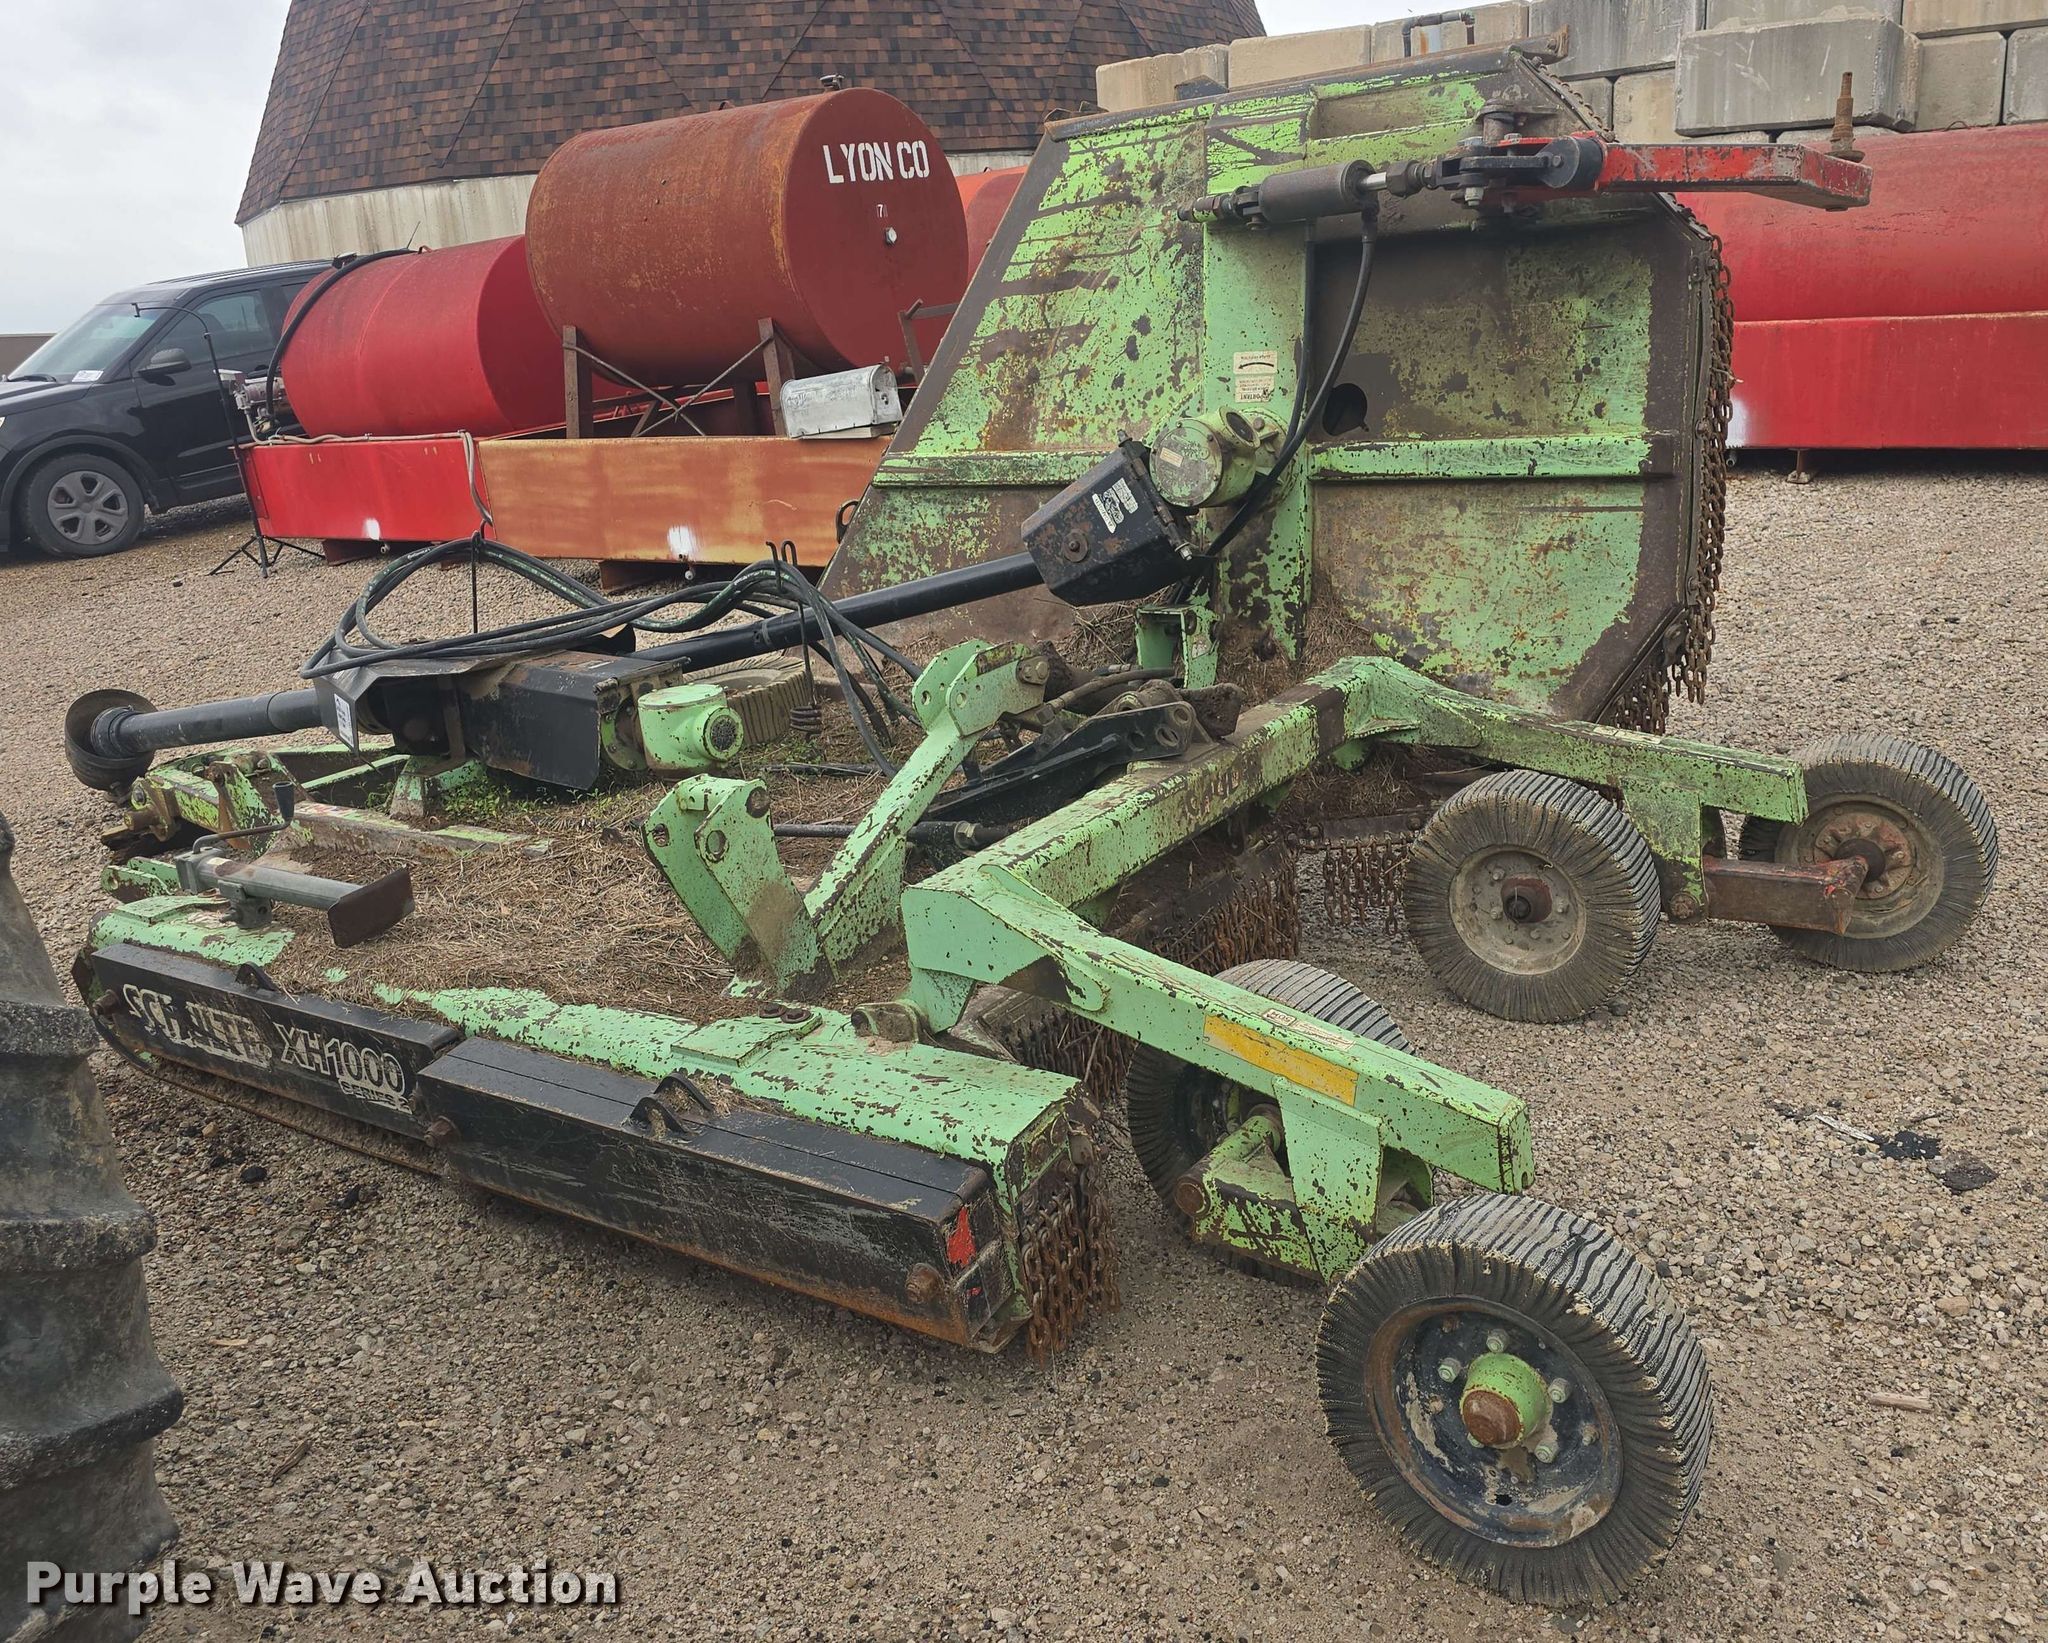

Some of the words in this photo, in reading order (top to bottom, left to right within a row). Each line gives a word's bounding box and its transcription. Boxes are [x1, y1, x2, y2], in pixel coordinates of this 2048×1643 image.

[822, 142, 894, 184] LYON
[896, 140, 931, 180] CO
[272, 1021, 405, 1096] XH1000
[340, 1079, 397, 1107] SERIES
